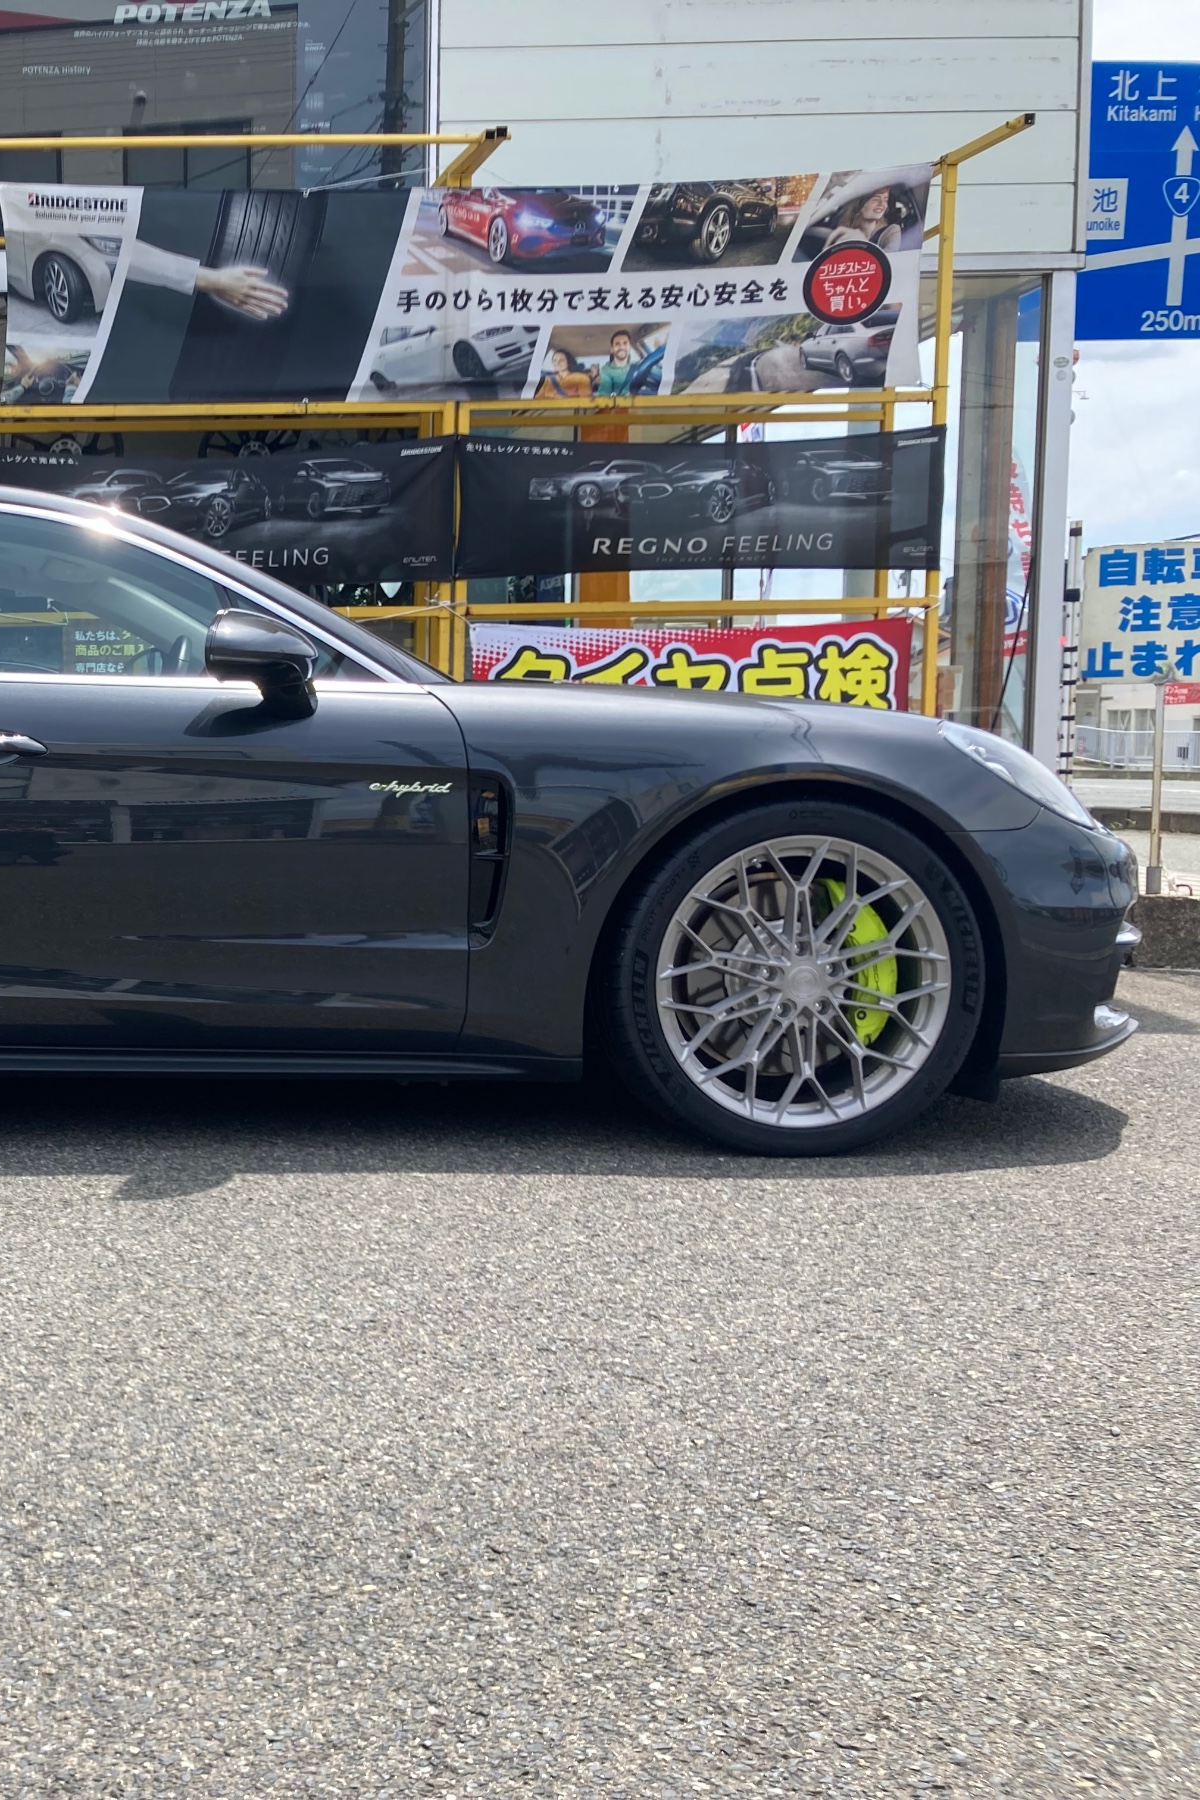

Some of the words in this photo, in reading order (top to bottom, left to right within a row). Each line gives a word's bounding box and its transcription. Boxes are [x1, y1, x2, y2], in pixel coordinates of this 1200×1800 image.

[113, 0, 271, 24] POTENZA
[22, 66, 59, 75] POTENZA
[62, 65, 91, 76] History
[1109, 70, 1178, 101] 北上
[1107, 106, 1177, 122] Kitakami
[28, 192, 128, 212] BRIDGESTONE
[1092, 187, 1118, 213] 池
[1174, 183, 1190, 203] 4
[35, 210, 67, 220] Solutions
[69, 213, 78, 222] for
[80, 214, 96, 223] your
[97, 214, 126, 225] journey
[396, 277, 789, 314] 手のひら1枚分で支える安心安全を
[823, 277, 870, 296] ちゃんと
[830, 295, 867, 312] 買い。
[592, 537, 708, 556] REGNO
[722, 533, 834, 553] FEELING
[220, 547, 329, 569] EELING
[1099, 548, 1200, 587] 自転
[1118, 593, 1200, 633] 注意
[75, 630, 140, 641] 私たちは、タ
[1082, 640, 1200, 678] 止まれ
[369, 781, 453, 798] e-hybrid
[944, 888, 980, 1016] MICHELIN
[632, 947, 669, 1075] MICHELIN
